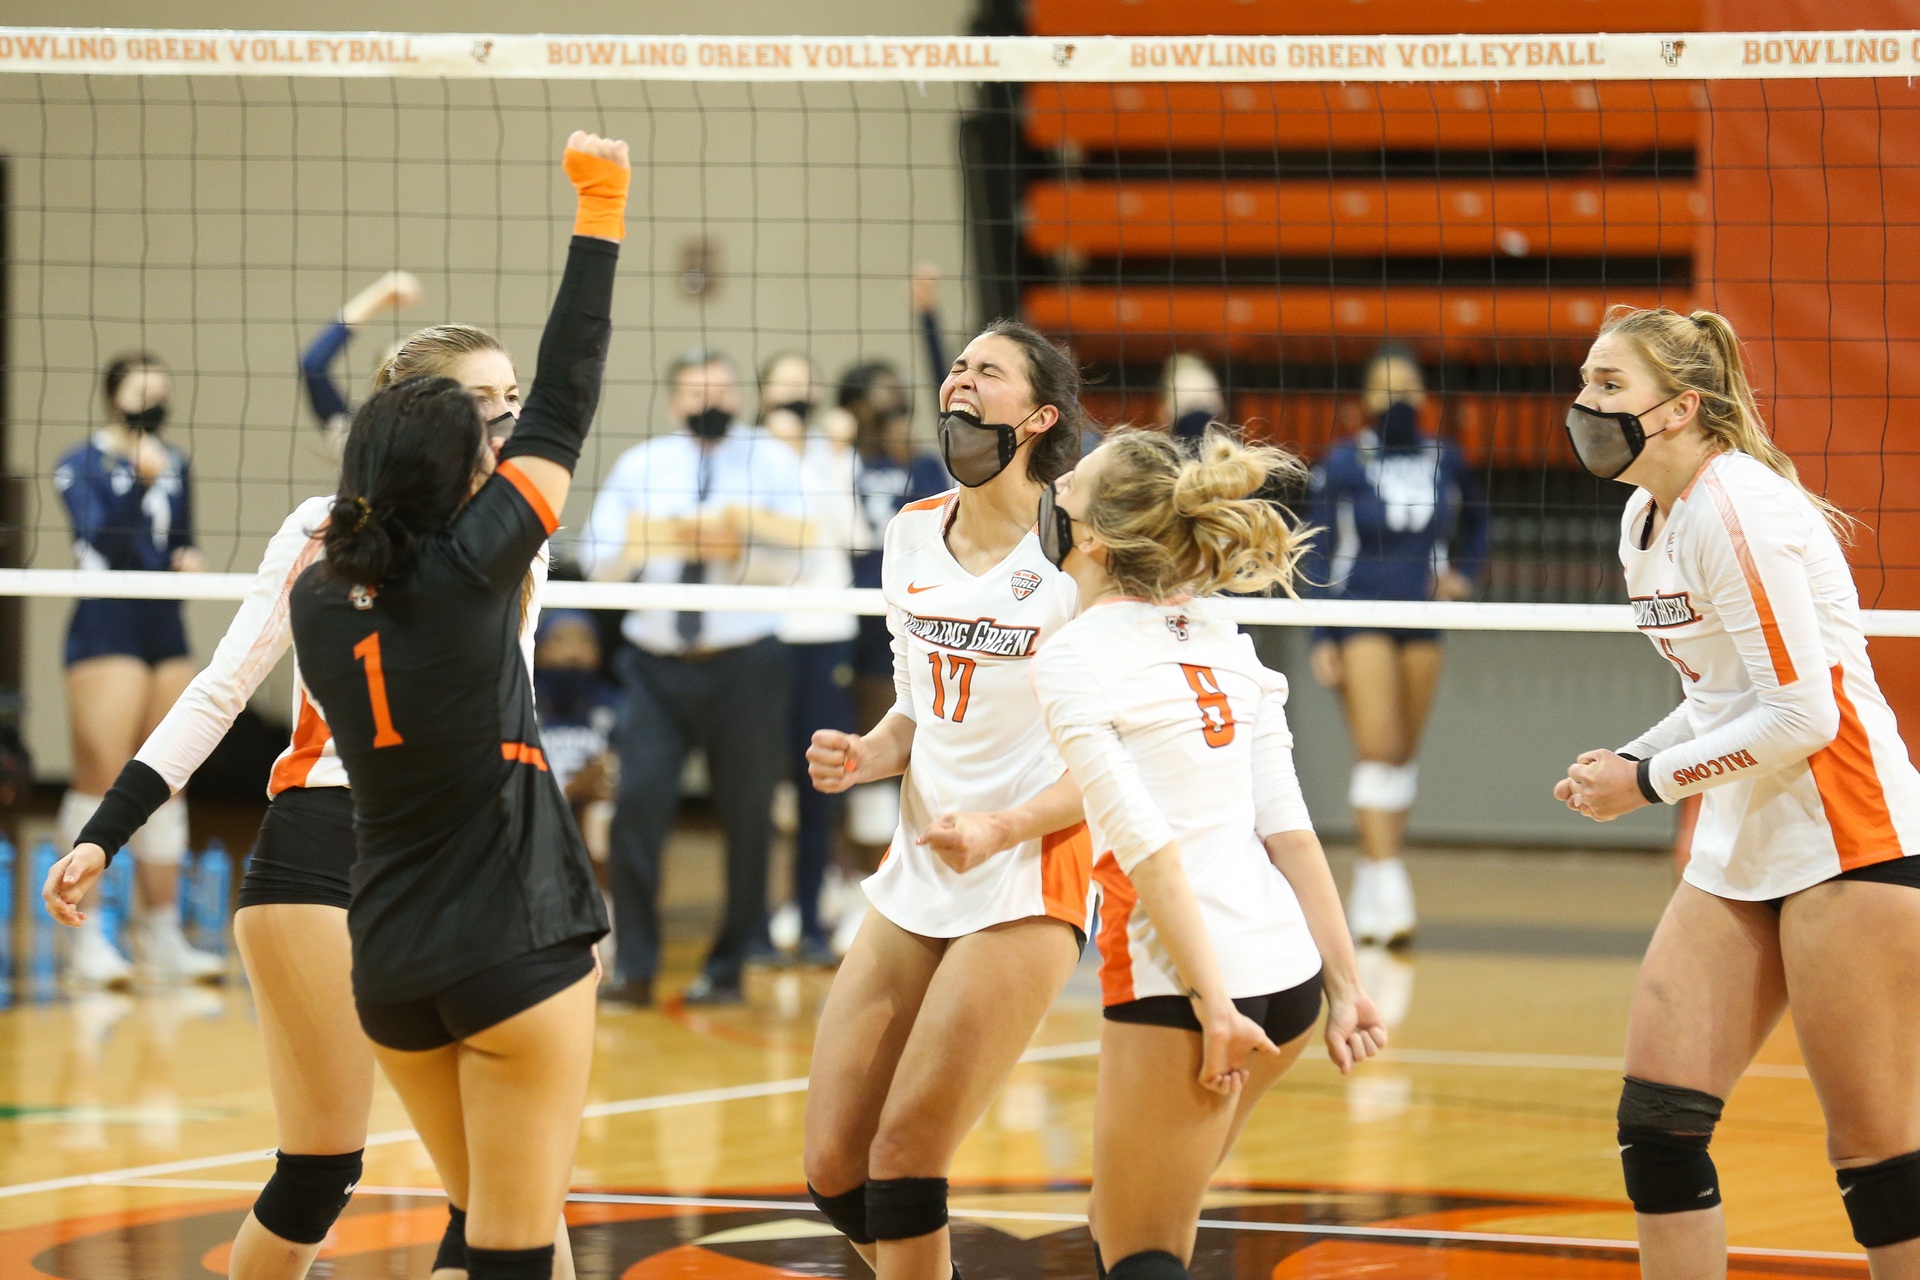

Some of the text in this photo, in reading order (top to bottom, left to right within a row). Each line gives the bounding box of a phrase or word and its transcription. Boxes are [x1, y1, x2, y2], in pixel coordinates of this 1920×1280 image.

[126, 38, 218, 61] GREEN
[229, 39, 419, 63] VOLLEYBALL
[546, 41, 1000, 68] BOWLING GREEN VOLLEYBALL
[1130, 42, 1605, 68] BOWLING GREEN VOLLEYBALL
[1743, 38, 1900, 65] BOWLING
[966, 621, 1036, 656] GREEN
[353, 631, 404, 749] 1
[927, 651, 977, 723] 17
[1673, 749, 1759, 787] FALCONS
